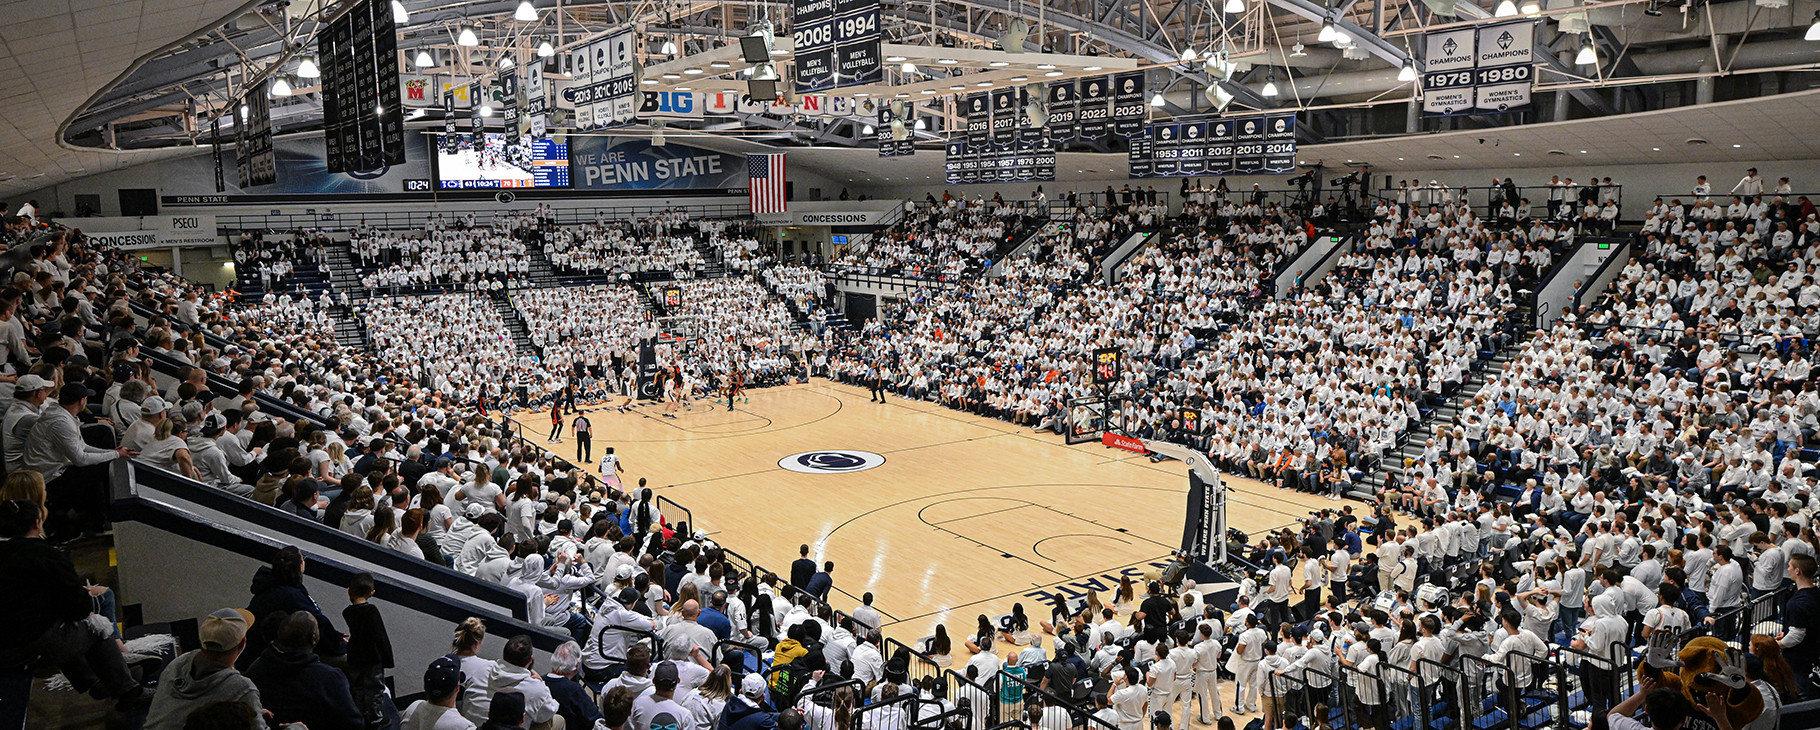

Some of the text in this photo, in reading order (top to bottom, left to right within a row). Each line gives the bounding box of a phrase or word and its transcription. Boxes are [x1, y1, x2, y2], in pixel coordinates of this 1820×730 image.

[796, 0, 831, 16] CHAMPIONS
[838, 14, 875, 38] 1994
[794, 24, 832, 48] 2008
[850, 50, 866, 59] MEN'S
[1482, 49, 1529, 60] CHAMPIONS
[842, 58, 874, 69] VOLLEYBALL
[1430, 55, 1472, 65] CHAMPIONS
[800, 66, 828, 76] VOLLEYBALL
[1480, 66, 1528, 83] 1980
[1428, 72, 1471, 87] 1978
[613, 79, 632, 94] 2009
[574, 89, 591, 103] 2013
[1484, 95, 1523, 103] GYMNASTICS
[804, 96, 819, 110] N
[1081, 109, 1106, 119] 2022
[1115, 106, 1143, 116] 2023
[1050, 112, 1073, 122] 2019
[969, 122, 987, 130] 2016
[994, 119, 1013, 128] 2017
[1182, 149, 1203, 157] 2011
[1208, 147, 1232, 156] 2012
[1237, 146, 1262, 154] 2013
[1266, 144, 1293, 153] 2014
[576, 151, 625, 165] WE ARE
[585, 161, 649, 186] PENN
[655, 155, 722, 180] STATE
[409, 181, 428, 190] 10:24
[173, 218, 198, 228] PSECU
[803, 214, 867, 223] CONCESSIONS
[90, 234, 156, 247] CONCESSIONS
[1201, 545, 1206, 556] WE
